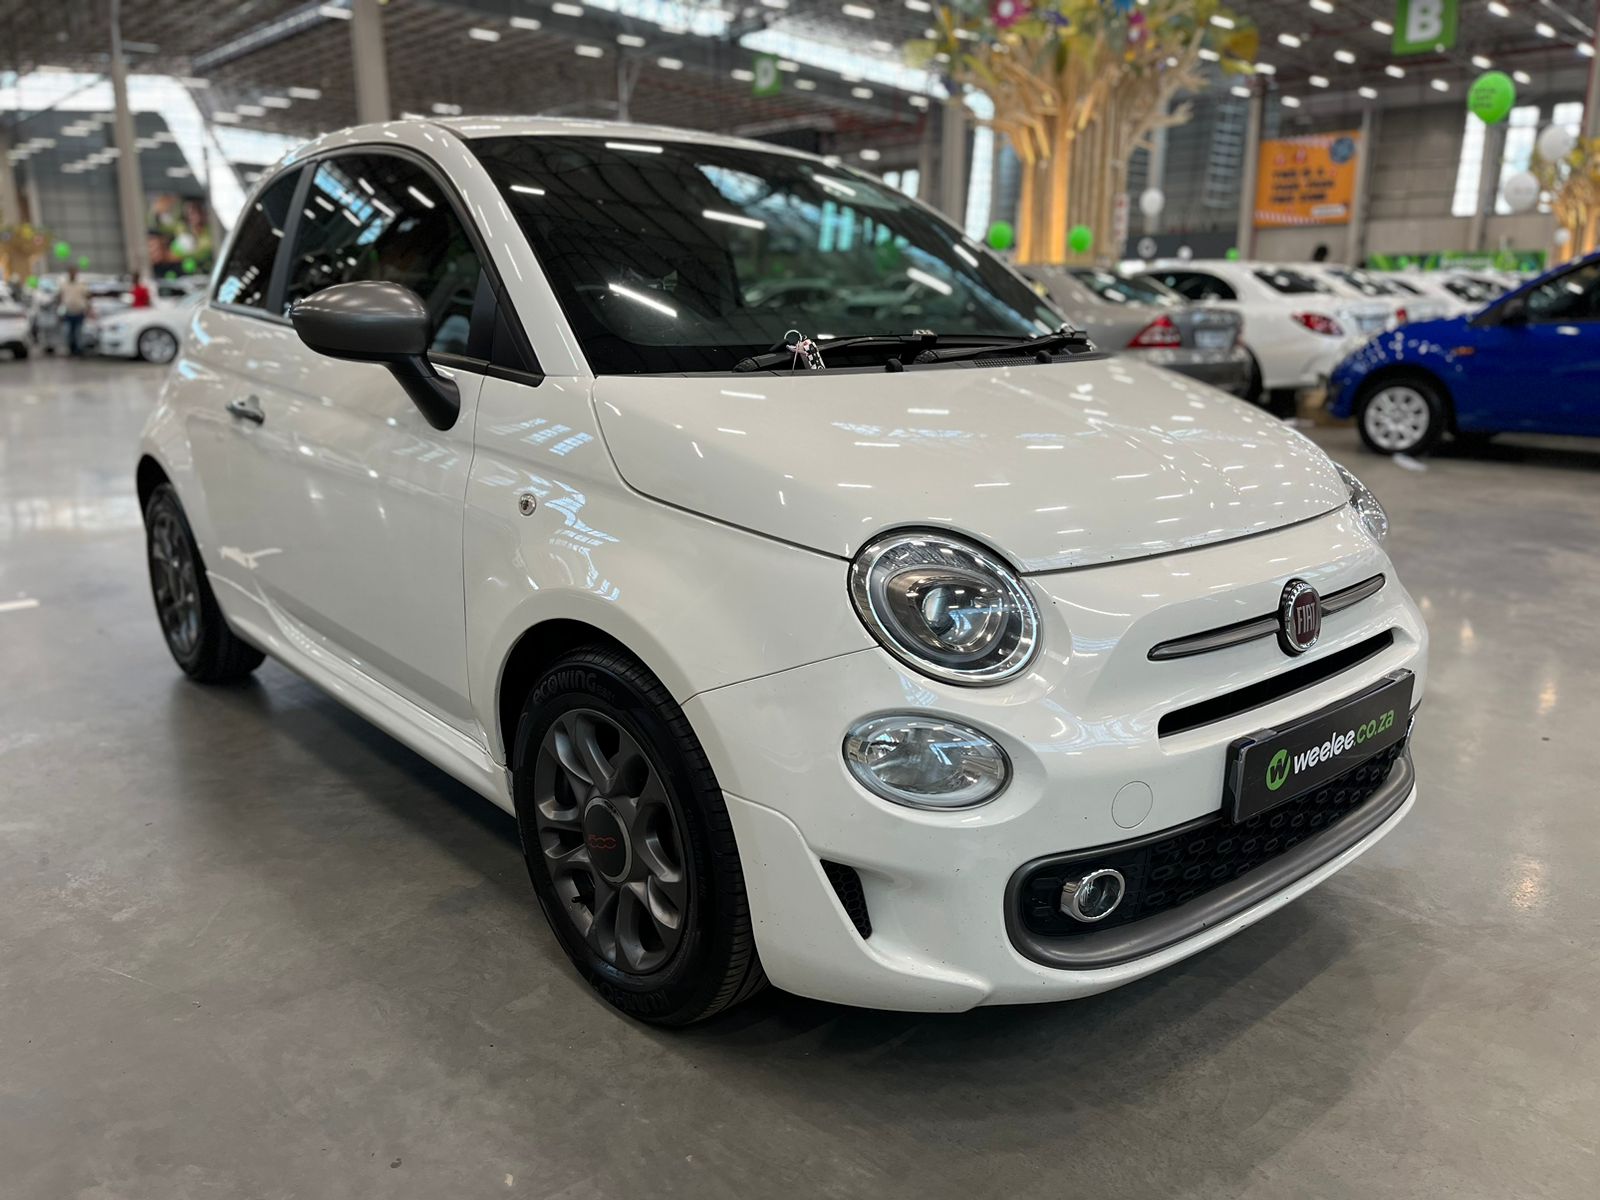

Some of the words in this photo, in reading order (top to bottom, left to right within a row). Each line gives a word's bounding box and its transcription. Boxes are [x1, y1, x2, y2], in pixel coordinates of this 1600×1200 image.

[1405, 0, 1444, 43] B
[1296, 602, 1316, 635] FIAT
[1293, 709, 1395, 775] weelee.co.za
